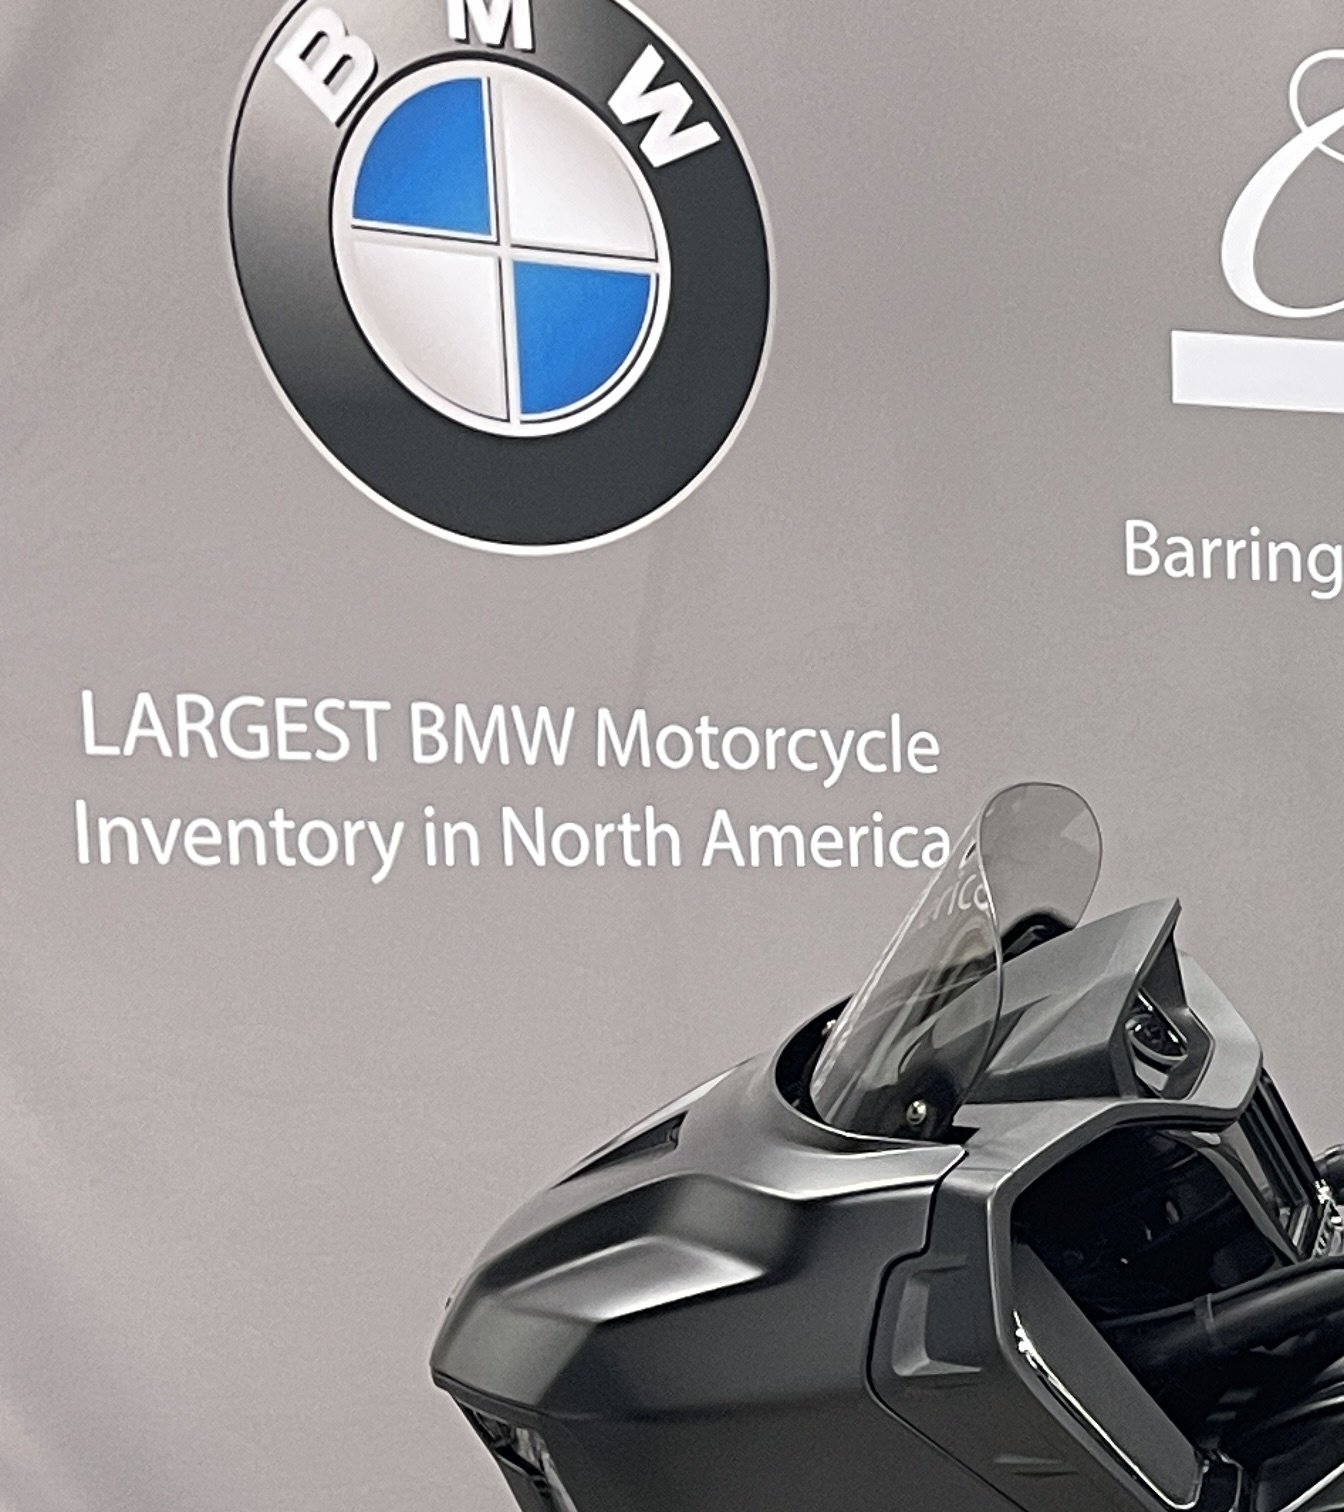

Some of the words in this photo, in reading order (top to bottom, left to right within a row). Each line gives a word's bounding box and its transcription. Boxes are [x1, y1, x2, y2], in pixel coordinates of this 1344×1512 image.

[275, 0, 720, 168] BMW
[81, 689, 392, 763] LARGEST
[410, 701, 576, 767] BMW
[597, 707, 940, 789] Motorcycle
[75, 799, 405, 885] Inventory
[424, 805, 480, 867] in
[502, 805, 682, 868] North
[701, 809, 950, 869] America
